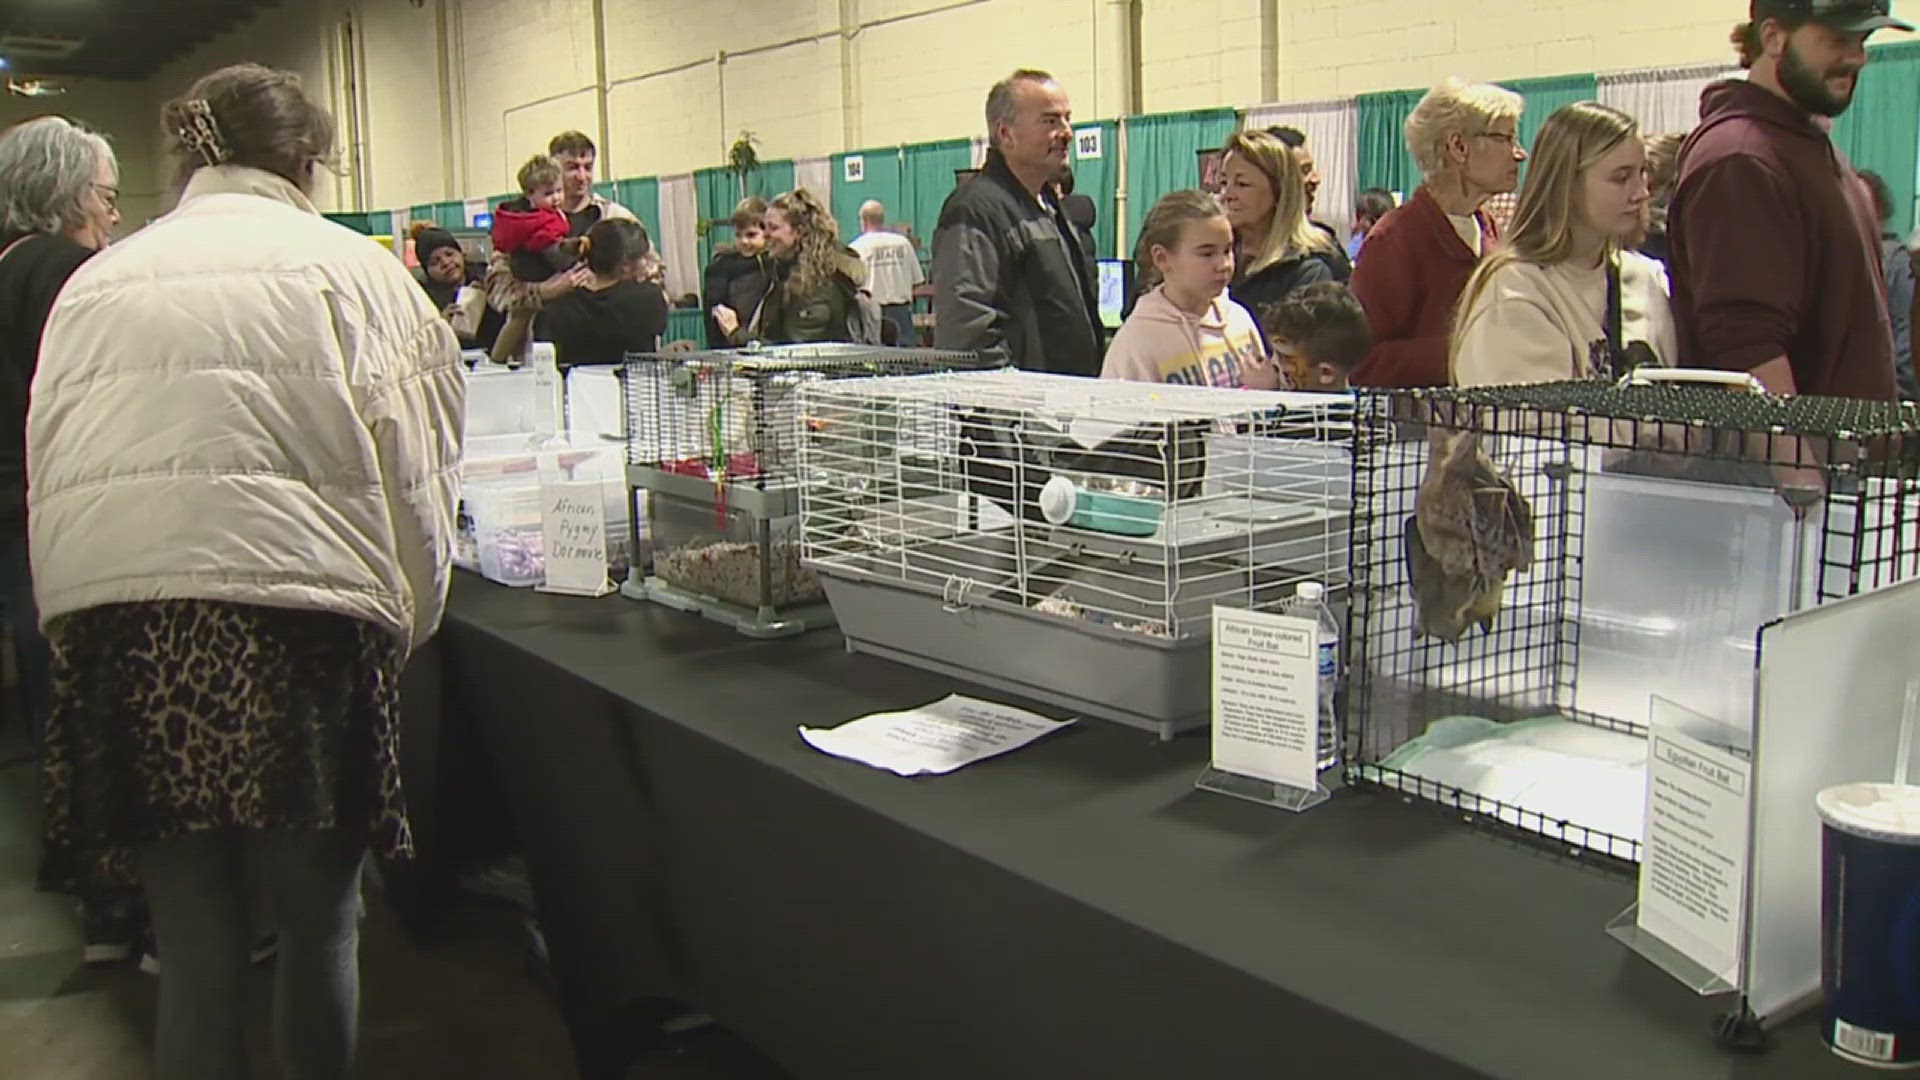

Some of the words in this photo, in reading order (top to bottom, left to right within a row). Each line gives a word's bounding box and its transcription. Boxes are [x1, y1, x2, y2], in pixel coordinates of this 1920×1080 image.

[1079, 134, 1097, 153] 103
[553, 497, 595, 516] African
[561, 519, 598, 543] Pygmy
[1224, 623, 1250, 636] African
[1248, 637, 1265, 648] Fruit
[1266, 641, 1280, 651] Bat
[1698, 761, 1715, 777] Fruit
[1717, 769, 1730, 785] Bat
